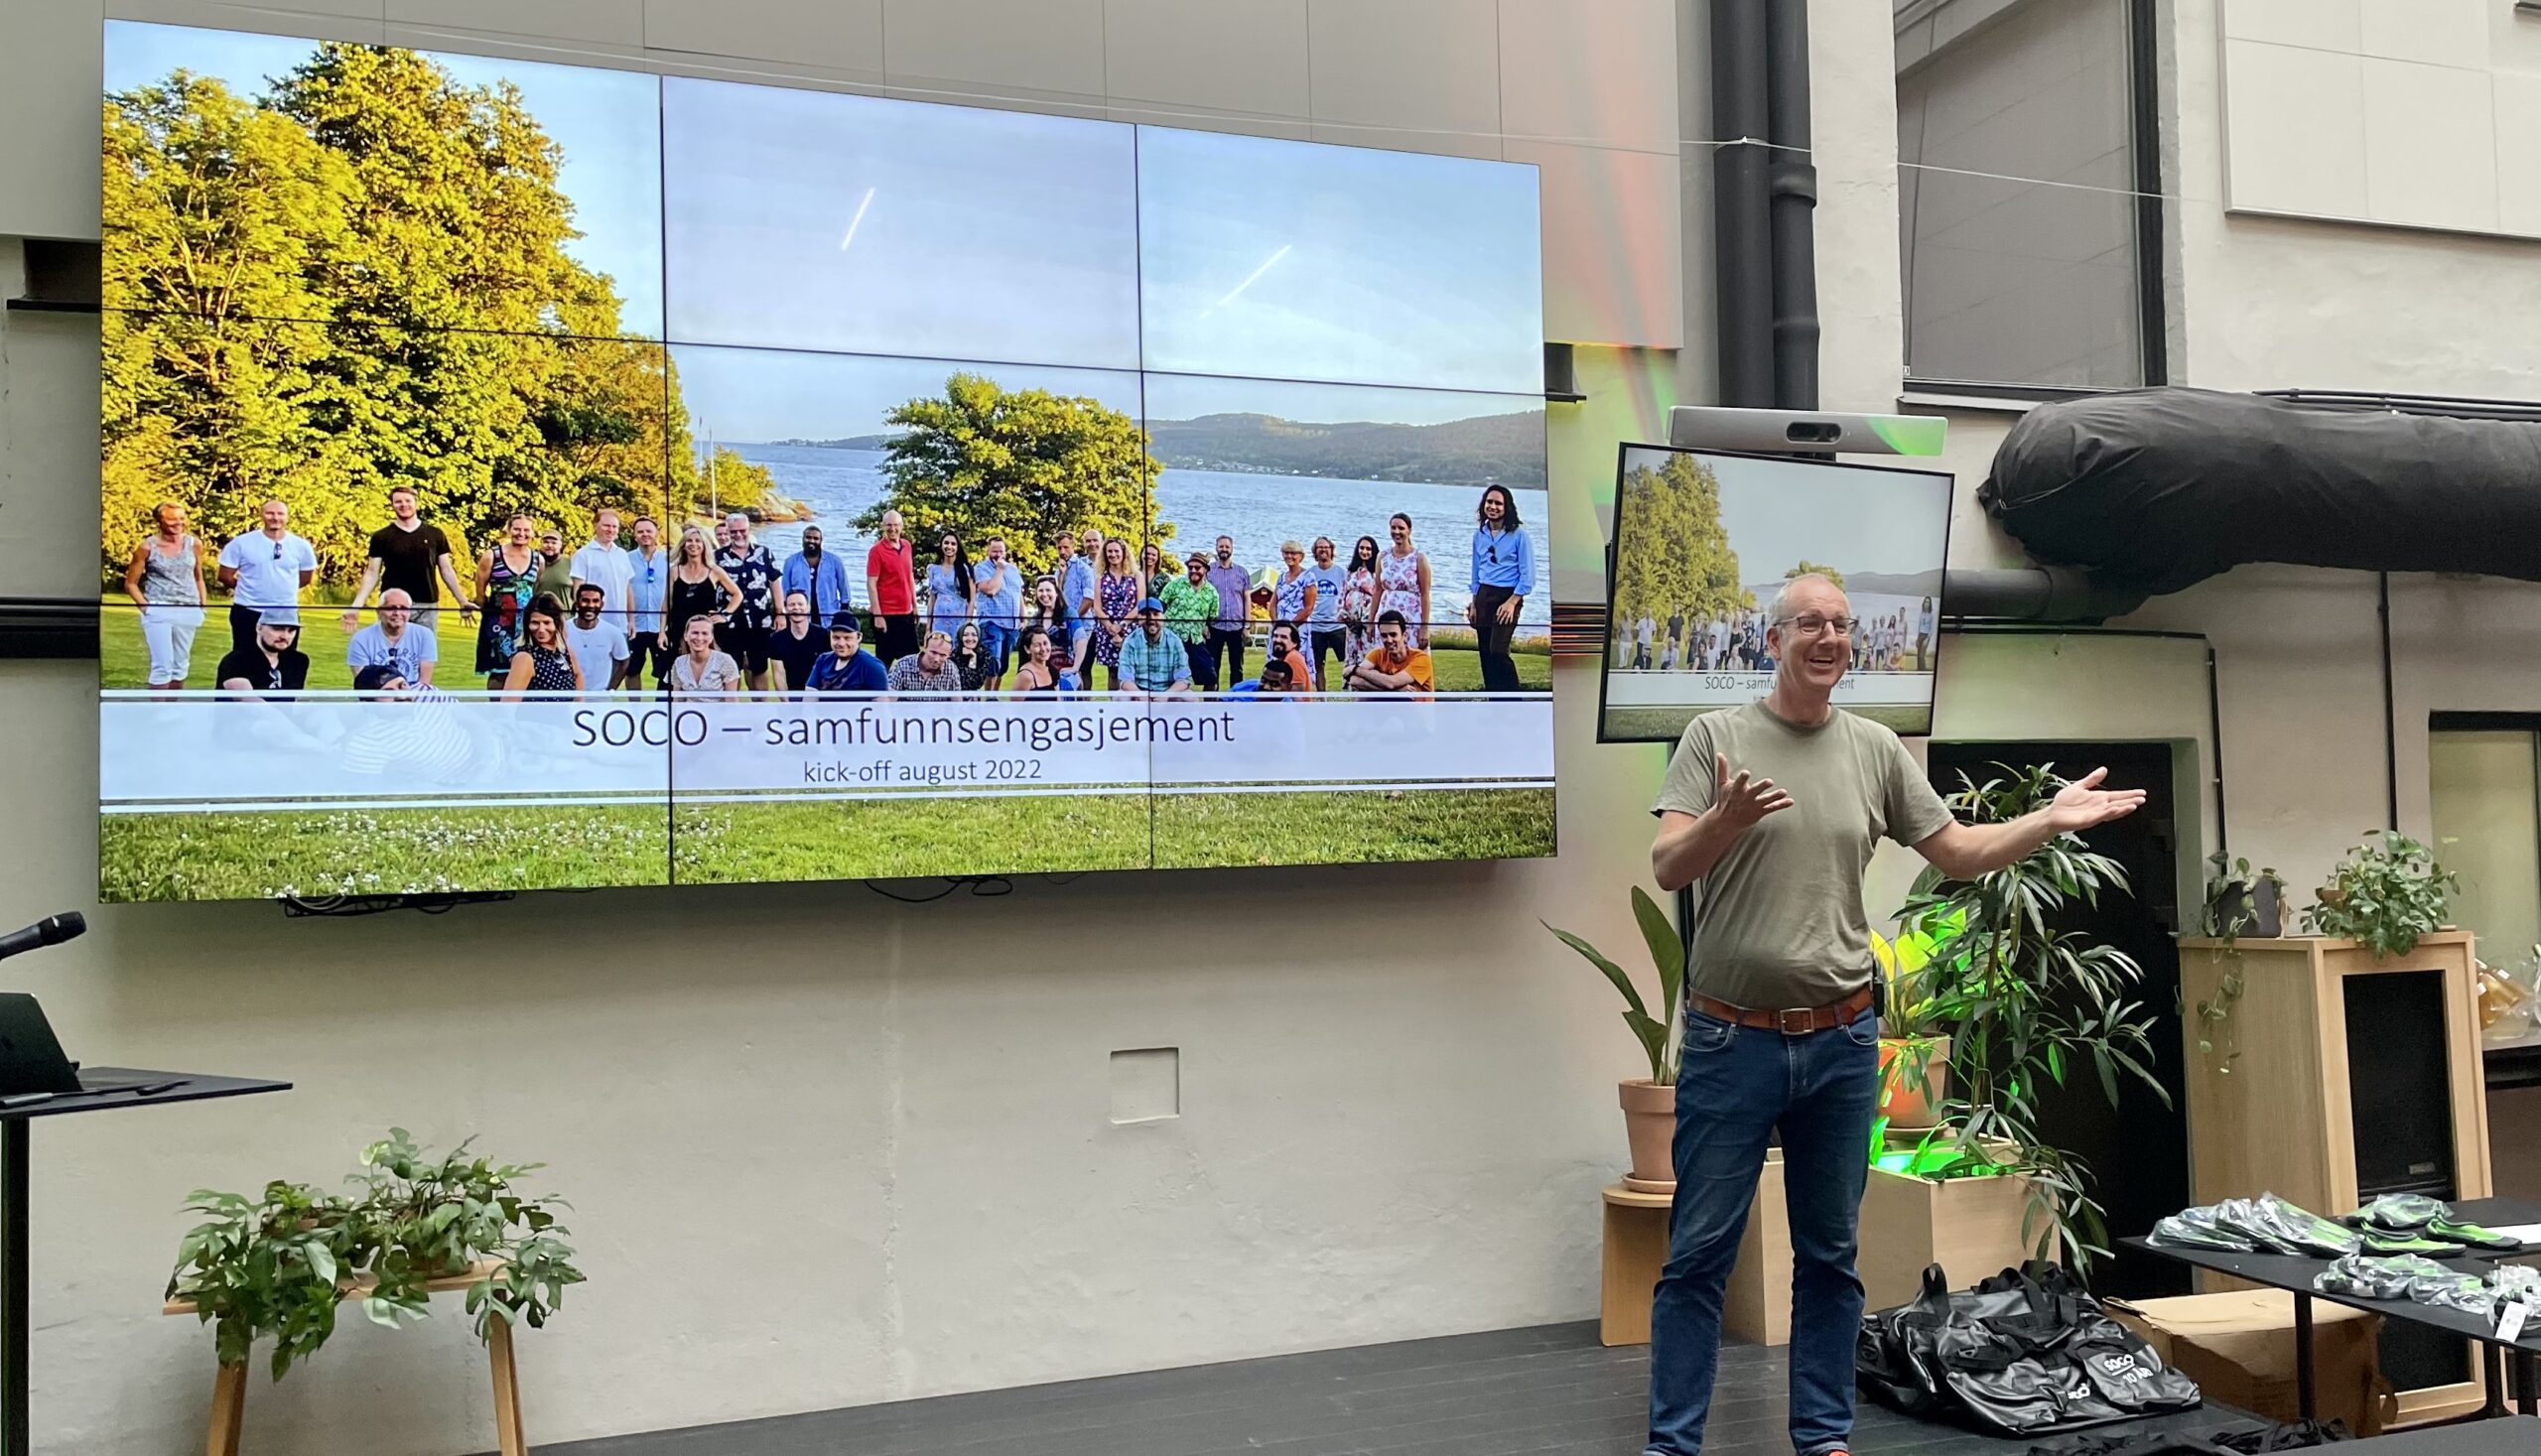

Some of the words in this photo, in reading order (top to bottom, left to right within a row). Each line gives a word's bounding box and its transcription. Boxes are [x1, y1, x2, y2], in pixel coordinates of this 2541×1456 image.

[1704, 676, 1735, 690] SOCO
[572, 709, 708, 746] SOCO
[764, 707, 1236, 751] samfunnsengasjement
[803, 759, 892, 783] kick-off
[898, 760, 978, 785] august
[985, 758, 1042, 779] 2022
[2103, 1354, 2134, 1372] SOCO
[2122, 1372, 2138, 1385] 10
